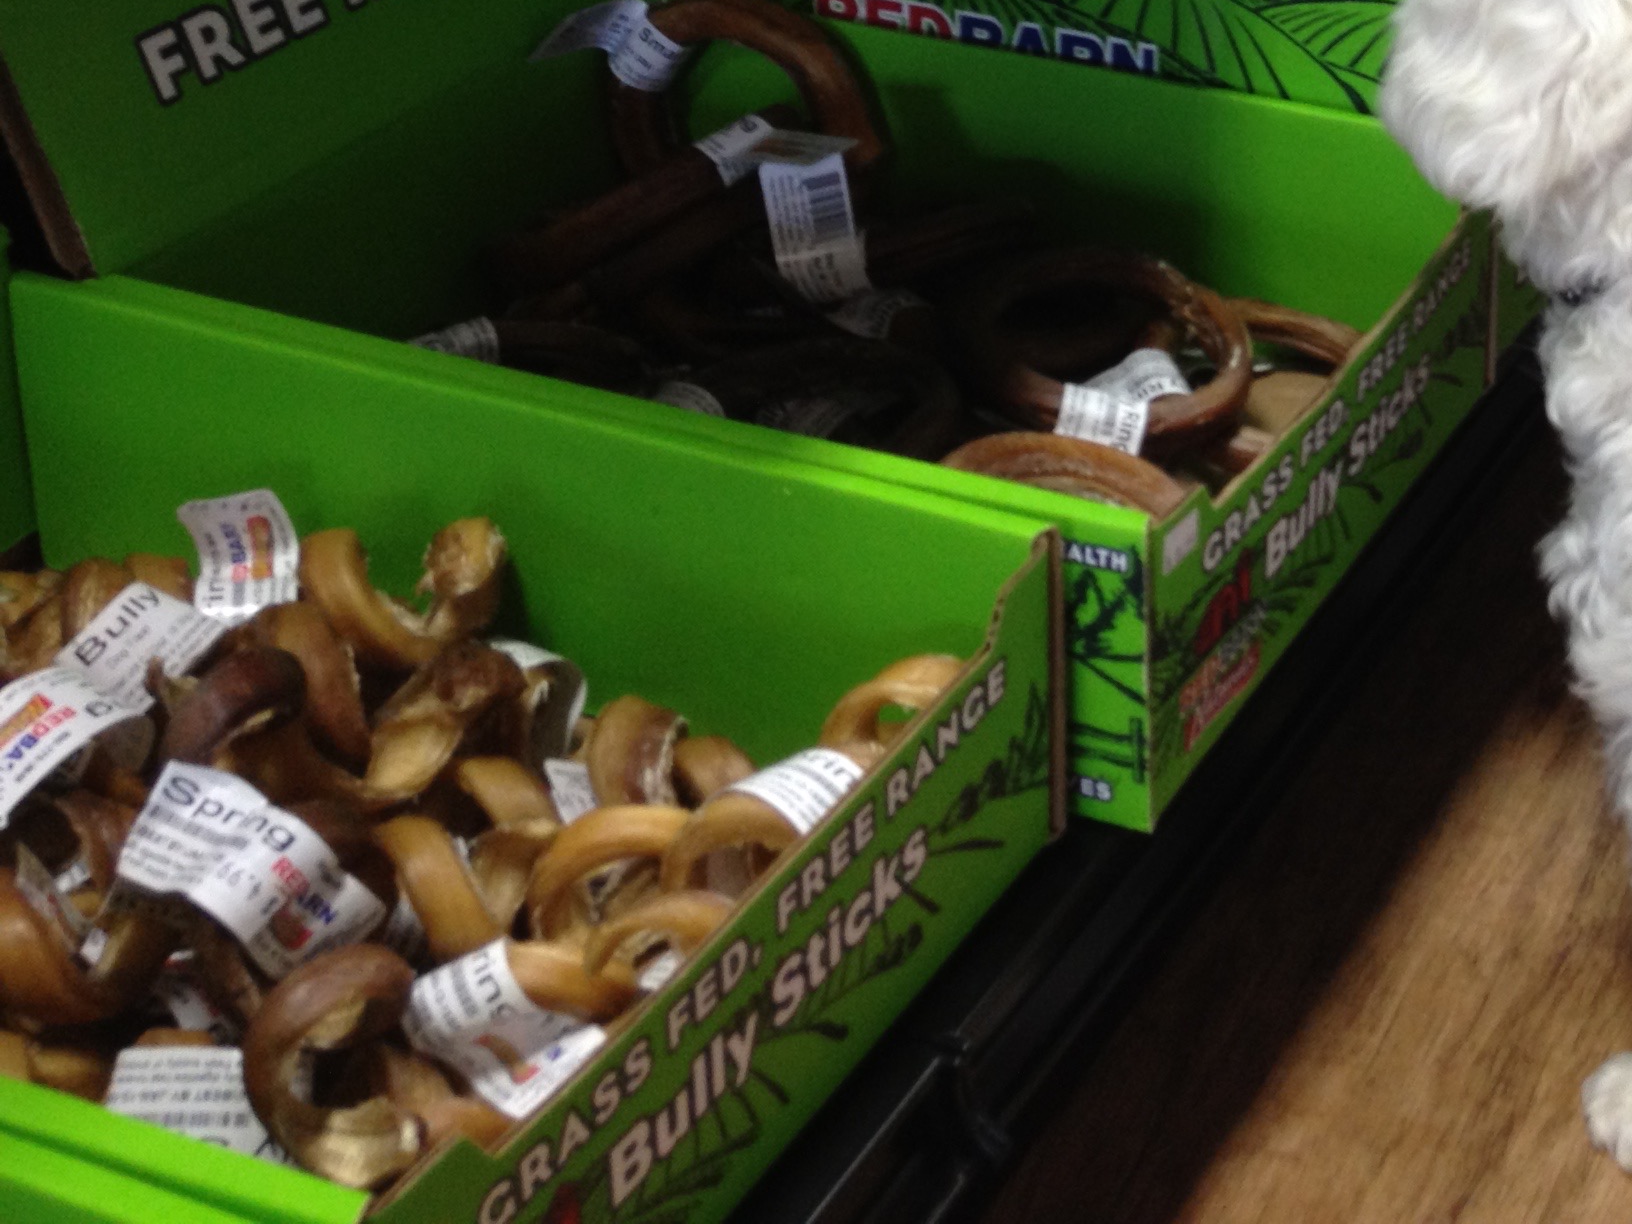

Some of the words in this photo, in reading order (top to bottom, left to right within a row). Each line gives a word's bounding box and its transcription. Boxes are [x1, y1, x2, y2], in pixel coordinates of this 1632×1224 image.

[1203, 453, 1293, 571] GRASS
[1357, 321, 1407, 403] FREE
[1265, 457, 1344, 579] Bully
[1349, 353, 1430, 476] Sticks
[74, 590, 160, 666] Bully
[477, 1037, 653, 1224] GRASS
[774, 810, 875, 935] FREE
[886, 660, 1006, 817] RANGE
[606, 1010, 757, 1213] Bully
[767, 827, 929, 1027] Sticks
